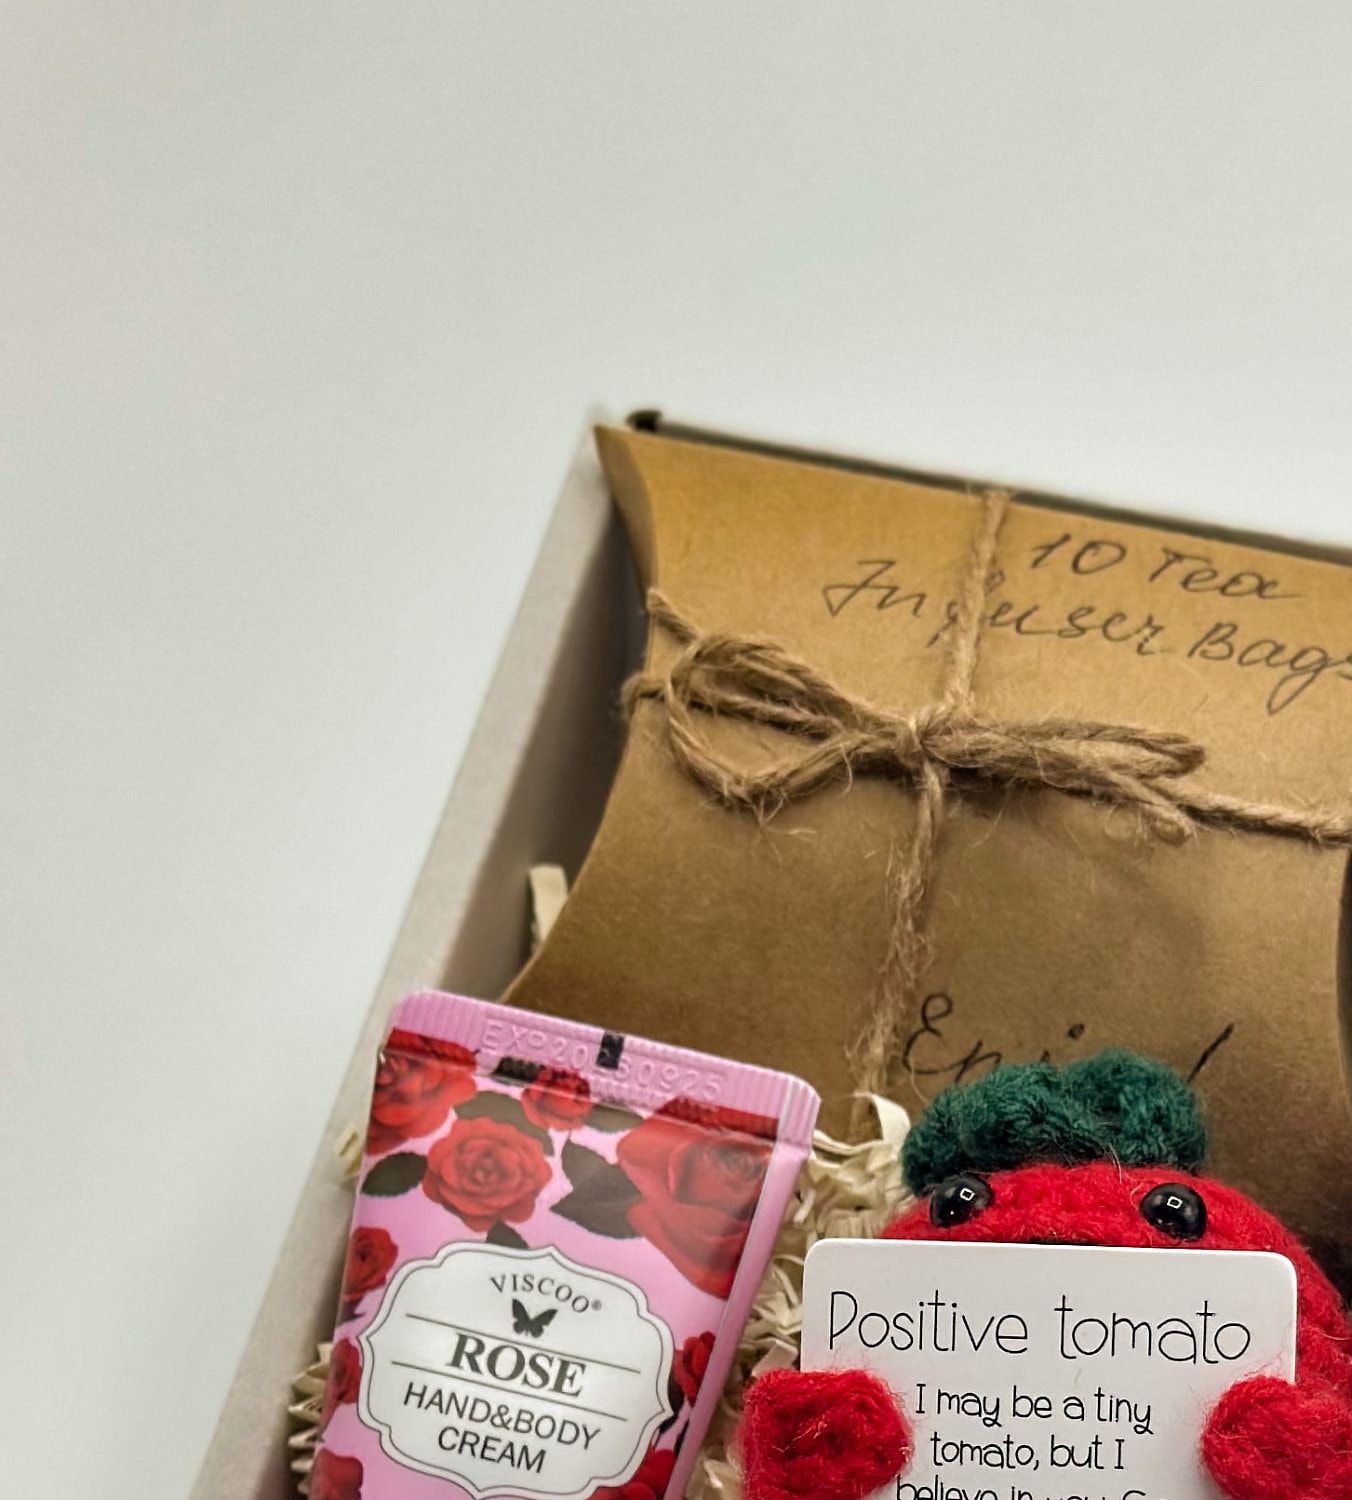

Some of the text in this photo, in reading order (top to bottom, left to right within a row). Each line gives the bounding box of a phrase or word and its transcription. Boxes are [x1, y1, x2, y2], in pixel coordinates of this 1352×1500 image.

[1029, 533, 1301, 600] 10 Tea
[828, 1289, 1252, 1365] Positive tomato
[445, 1331, 587, 1398] ROSE
[402, 1381, 602, 1451] HAND&BODY
[914, 1383, 1154, 1435] I may be a tiny
[437, 1425, 548, 1475] CREAM
[930, 1431, 1126, 1472] tomato, but I
